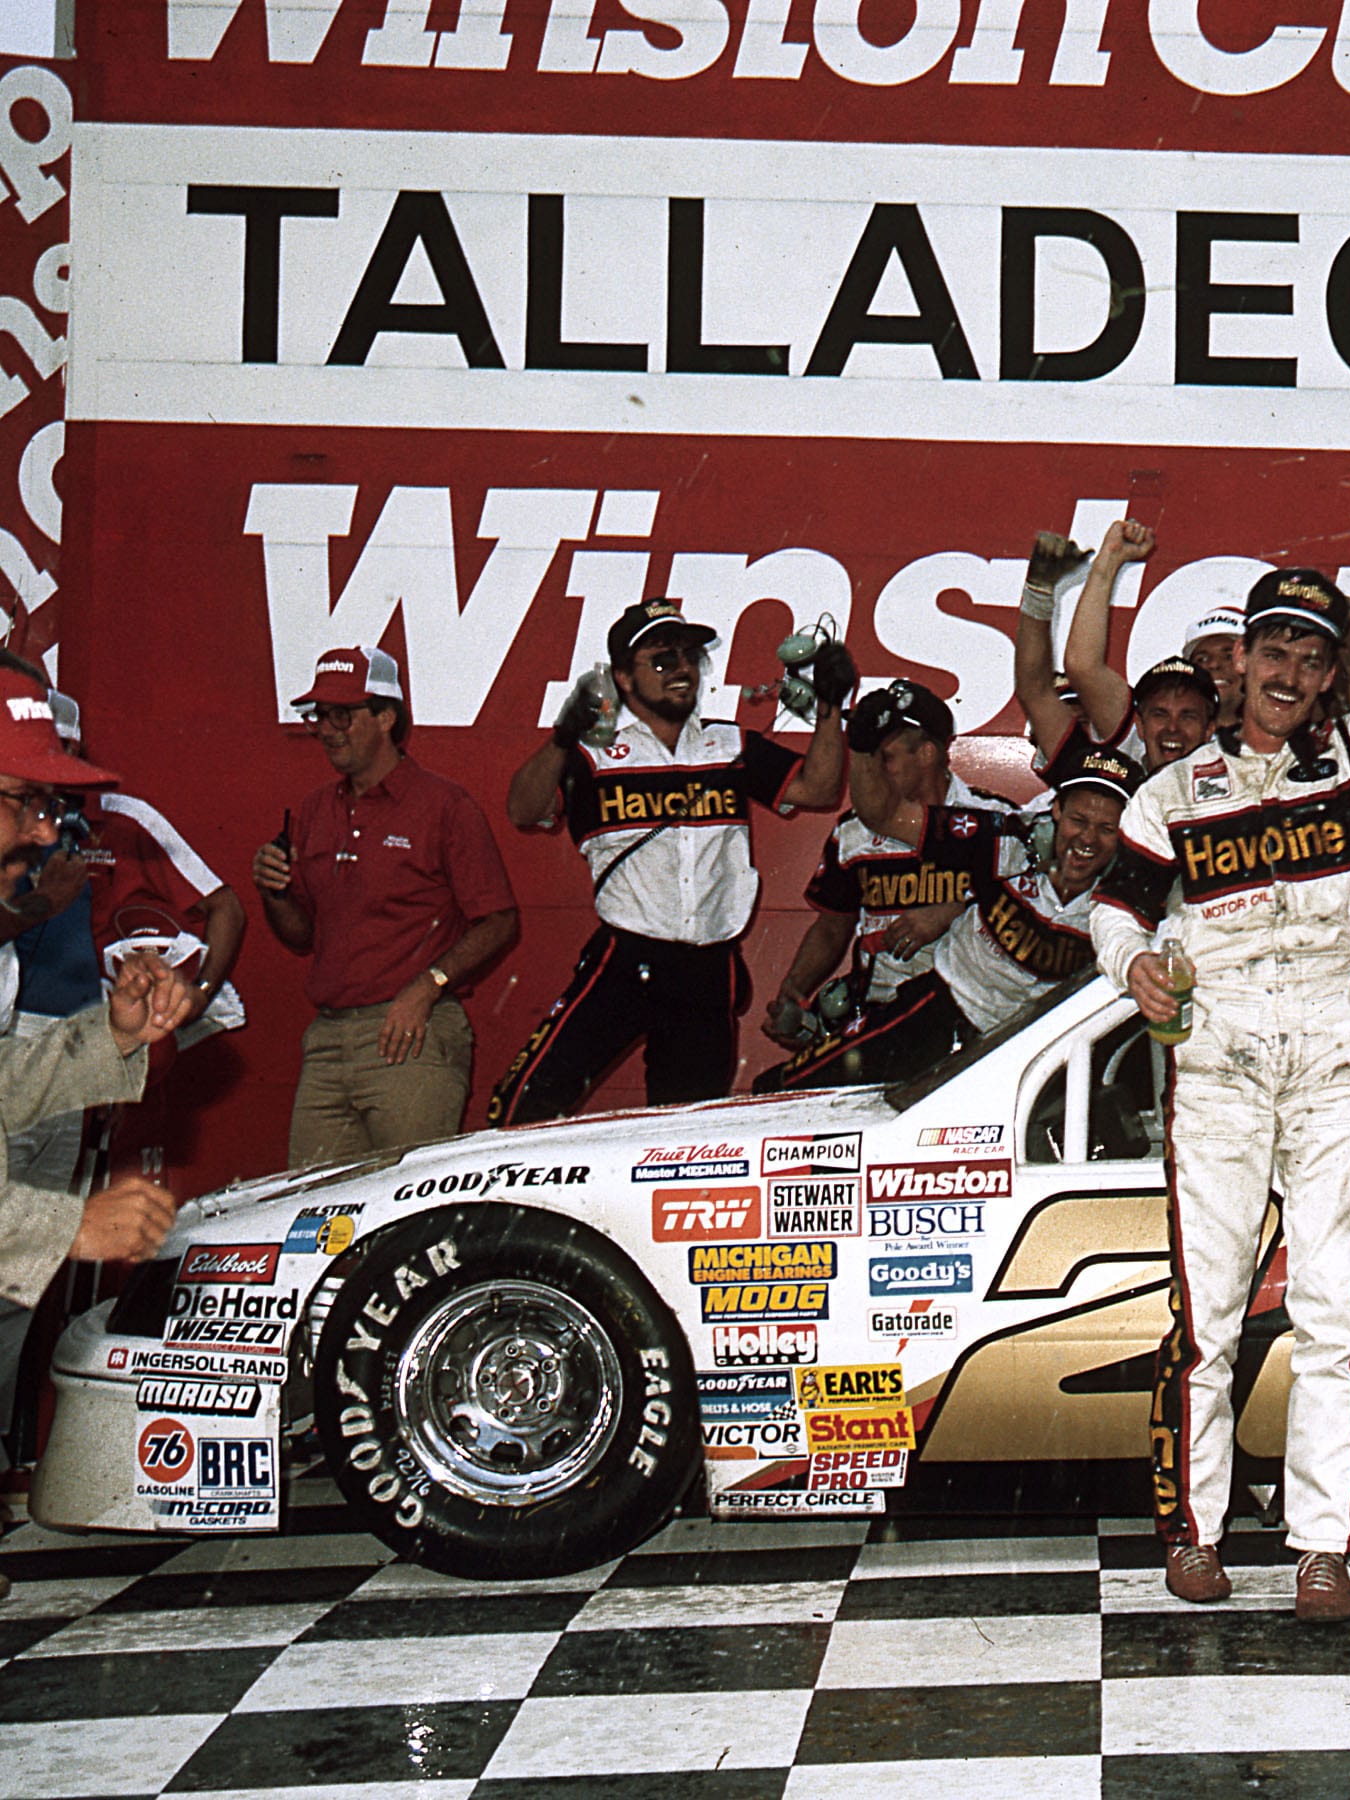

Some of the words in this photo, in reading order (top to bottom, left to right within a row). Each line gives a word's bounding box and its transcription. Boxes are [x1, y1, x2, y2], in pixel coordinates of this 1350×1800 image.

[600, 784, 738, 823] Havoline
[1184, 818, 1347, 882] Havoine
[1249, 891, 1273, 907] OIL
[943, 1125, 1001, 1145] NASCAR
[677, 1142, 745, 1164] Value
[766, 1143, 856, 1162] CHAMPION
[952, 1146, 979, 1155] RACE
[983, 1145, 1006, 1154] CAR
[393, 1162, 591, 1201] GOODYEAR
[635, 1165, 676, 1180] Master
[869, 1165, 1010, 1198] Winston
[773, 1183, 855, 1207] STEWART
[298, 1202, 366, 1219] BILSTEIN
[661, 1198, 753, 1231] TRW
[774, 1209, 853, 1233] WARNER
[867, 1205, 986, 1238] BUSCH
[187, 1251, 270, 1275] Edelbrock
[692, 1243, 833, 1269] MICHIGAN
[693, 1267, 750, 1283] ENGINE
[751, 1265, 833, 1281] BEARINGS
[870, 1260, 972, 1290] Goody's
[169, 1287, 299, 1320] DieHard
[704, 1283, 828, 1313] MOOG
[169, 1319, 284, 1345] WISECO
[871, 1311, 953, 1332] Gatorade
[715, 1325, 817, 1364] Holley
[131, 1351, 286, 1377] INGERSOLL-RAND
[716, 1355, 791, 1366] CARBS
[696, 1373, 788, 1393] GOODYEAR
[824, 1369, 902, 1396] EARL'S
[138, 1379, 257, 1411] MOROSO
[627, 1346, 672, 1479] EAGLE
[701, 1423, 801, 1446] VICTOR
[809, 1410, 913, 1443] Stant
[143, 1430, 187, 1470] 76
[812, 1449, 901, 1472] SPEED
[201, 1440, 270, 1487] BRC
[137, 1485, 196, 1496] GASOLINE
[811, 1470, 868, 1490] PRO
[713, 1493, 803, 1507] PERFECT
[804, 1492, 876, 1506] CIRCLE
[189, 1516, 248, 1526] GASKETS
